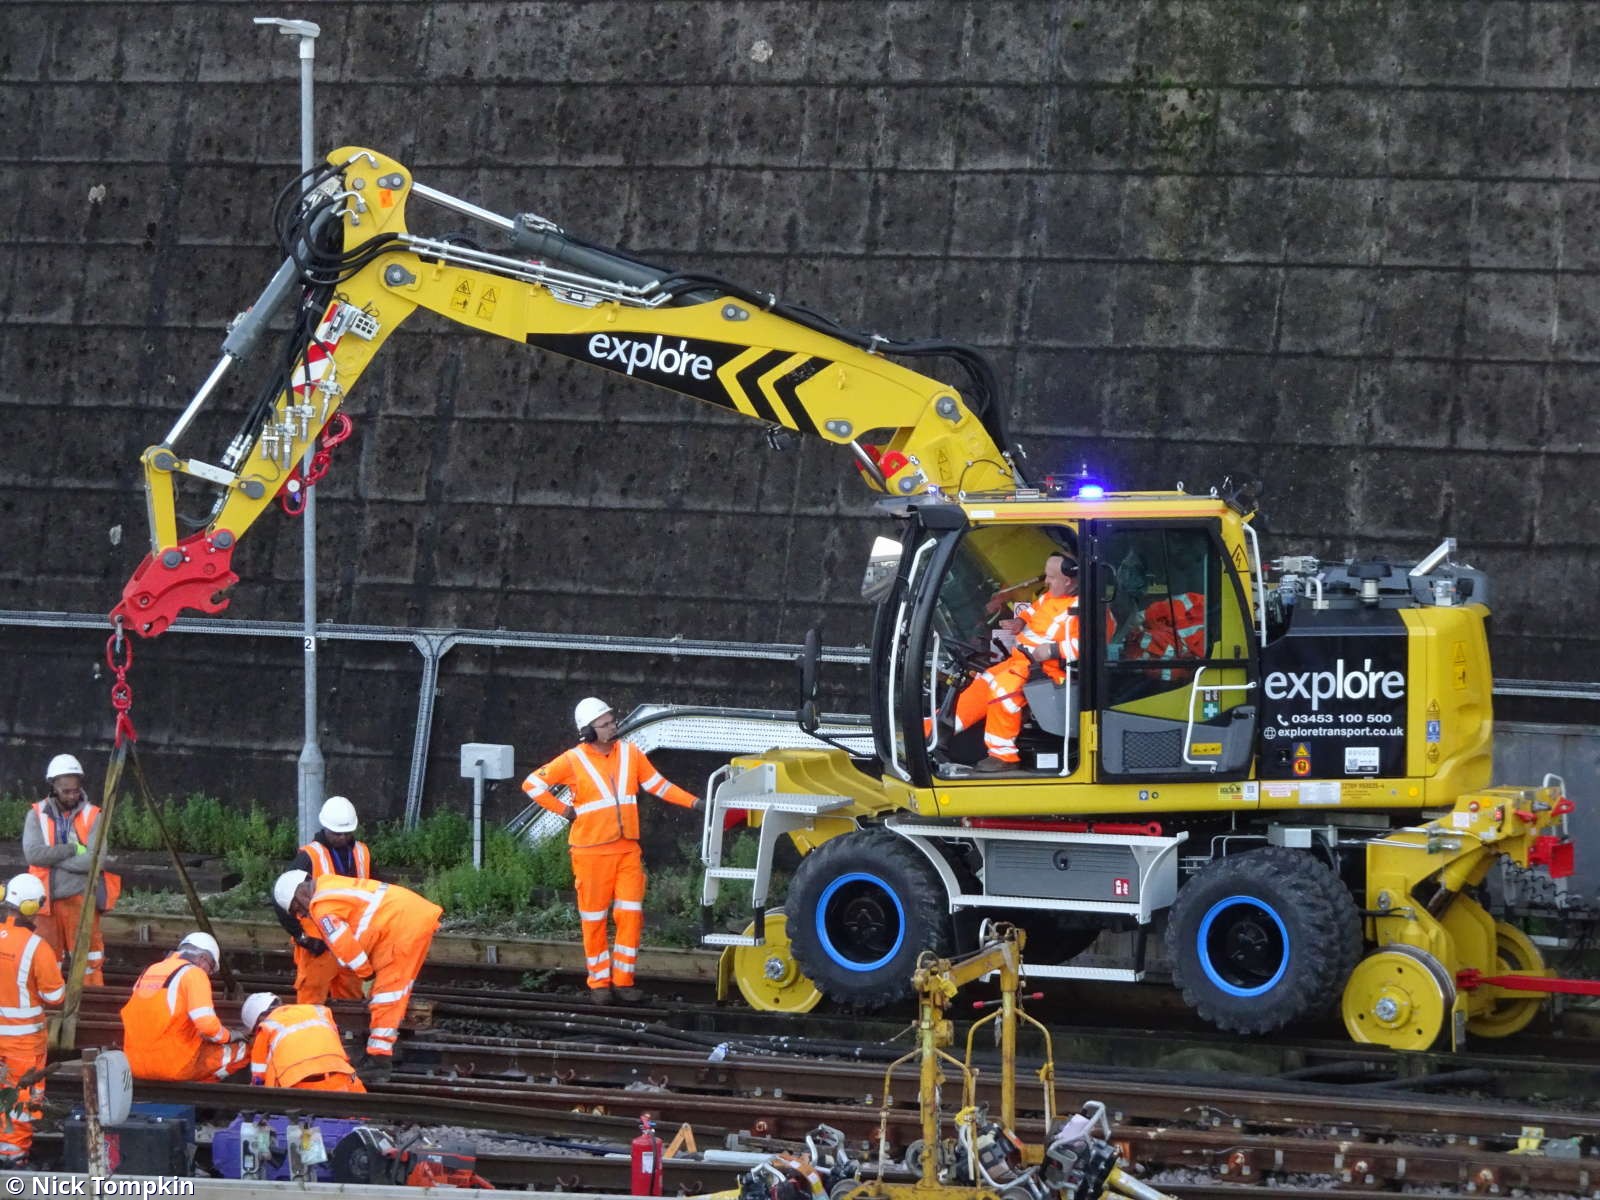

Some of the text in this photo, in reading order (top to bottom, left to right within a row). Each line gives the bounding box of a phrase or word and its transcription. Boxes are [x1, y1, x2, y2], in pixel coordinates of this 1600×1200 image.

[588, 333, 713, 380] explore
[304, 637, 312, 650] 2
[1264, 658, 1405, 711] explore
[1291, 714, 1393, 724] 03453 100 500
[1277, 726, 1404, 738] exploretransport.co.uk
